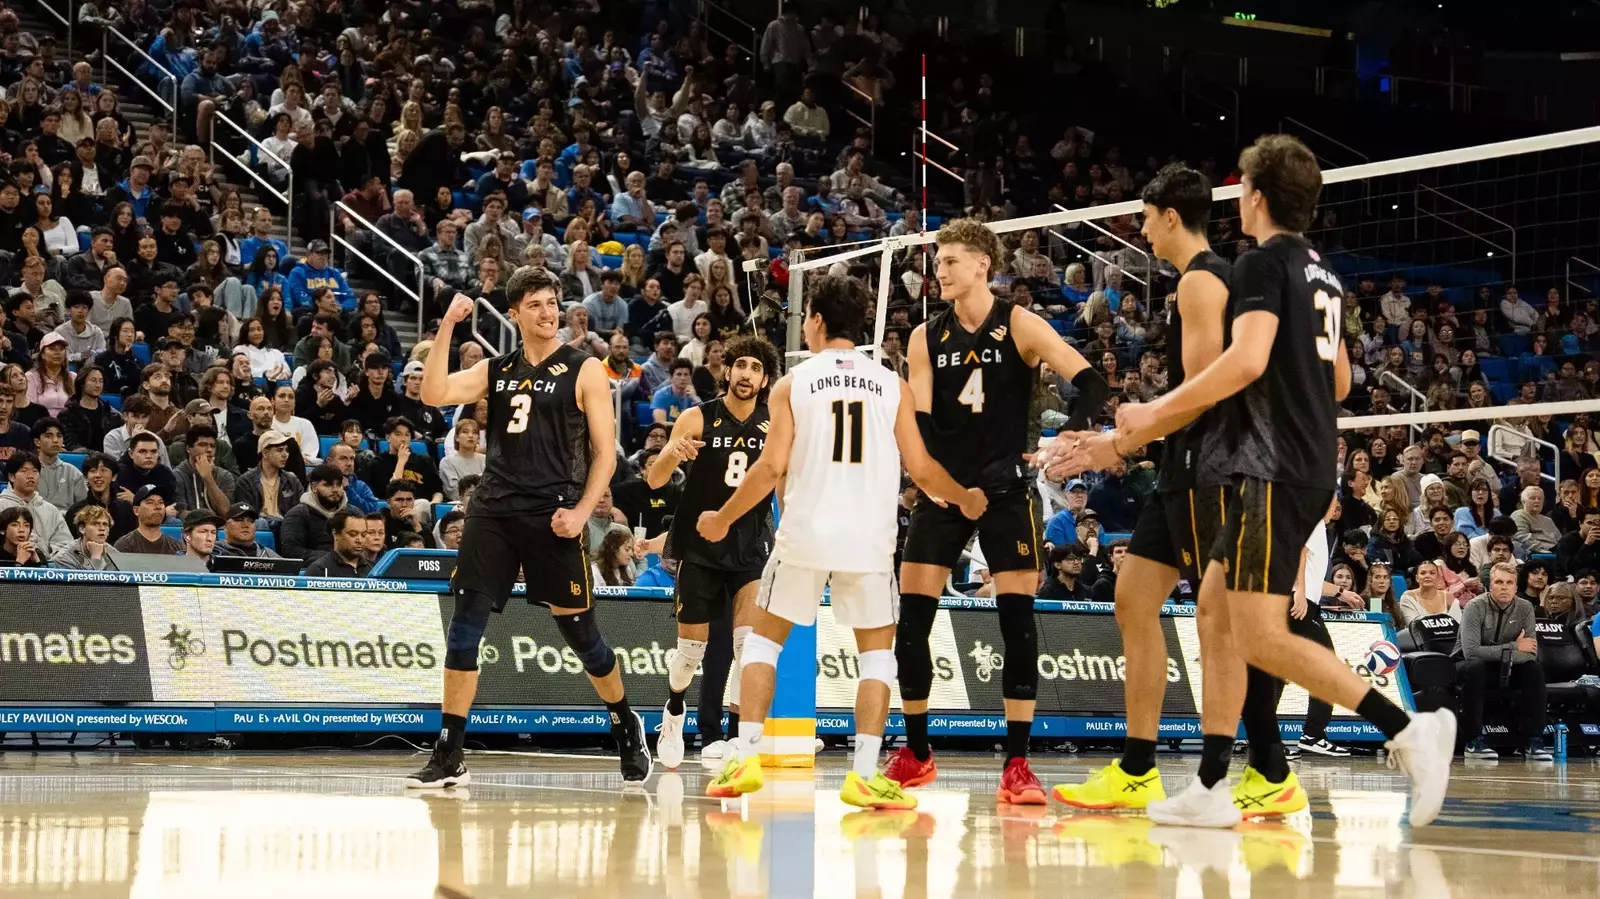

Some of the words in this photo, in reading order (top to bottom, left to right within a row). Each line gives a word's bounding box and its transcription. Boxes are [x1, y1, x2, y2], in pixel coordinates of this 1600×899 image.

[496, 379, 556, 394] BEACH
[810, 375, 840, 394] LONG
[844, 375, 882, 397] BEACH
[957, 367, 985, 413] 4
[506, 393, 532, 434] 3
[831, 399, 863, 463] 11
[724, 451, 748, 487] 8
[418, 560, 441, 572] POSS
[368, 581, 407, 590] WESCOM
[1421, 617, 1455, 629] READY
[222, 630, 436, 670] Postmates
[23, 713, 74, 723] PAVILION
[77, 714, 127, 726] presented
[129, 714, 142, 726] by
[144, 714, 188, 725] WESCOM
[322, 713, 368, 725] presented
[370, 713, 382, 725] by
[384, 713, 424, 723] WESCOM
[596, 714, 607, 727] by
[815, 718, 849, 728] WESCOM
[949, 719, 986, 730] presented
[987, 719, 997, 730] by
[1085, 722, 1113, 731] PAULEY
[1187, 722, 1197, 734] by
[1353, 725, 1362, 735] by
